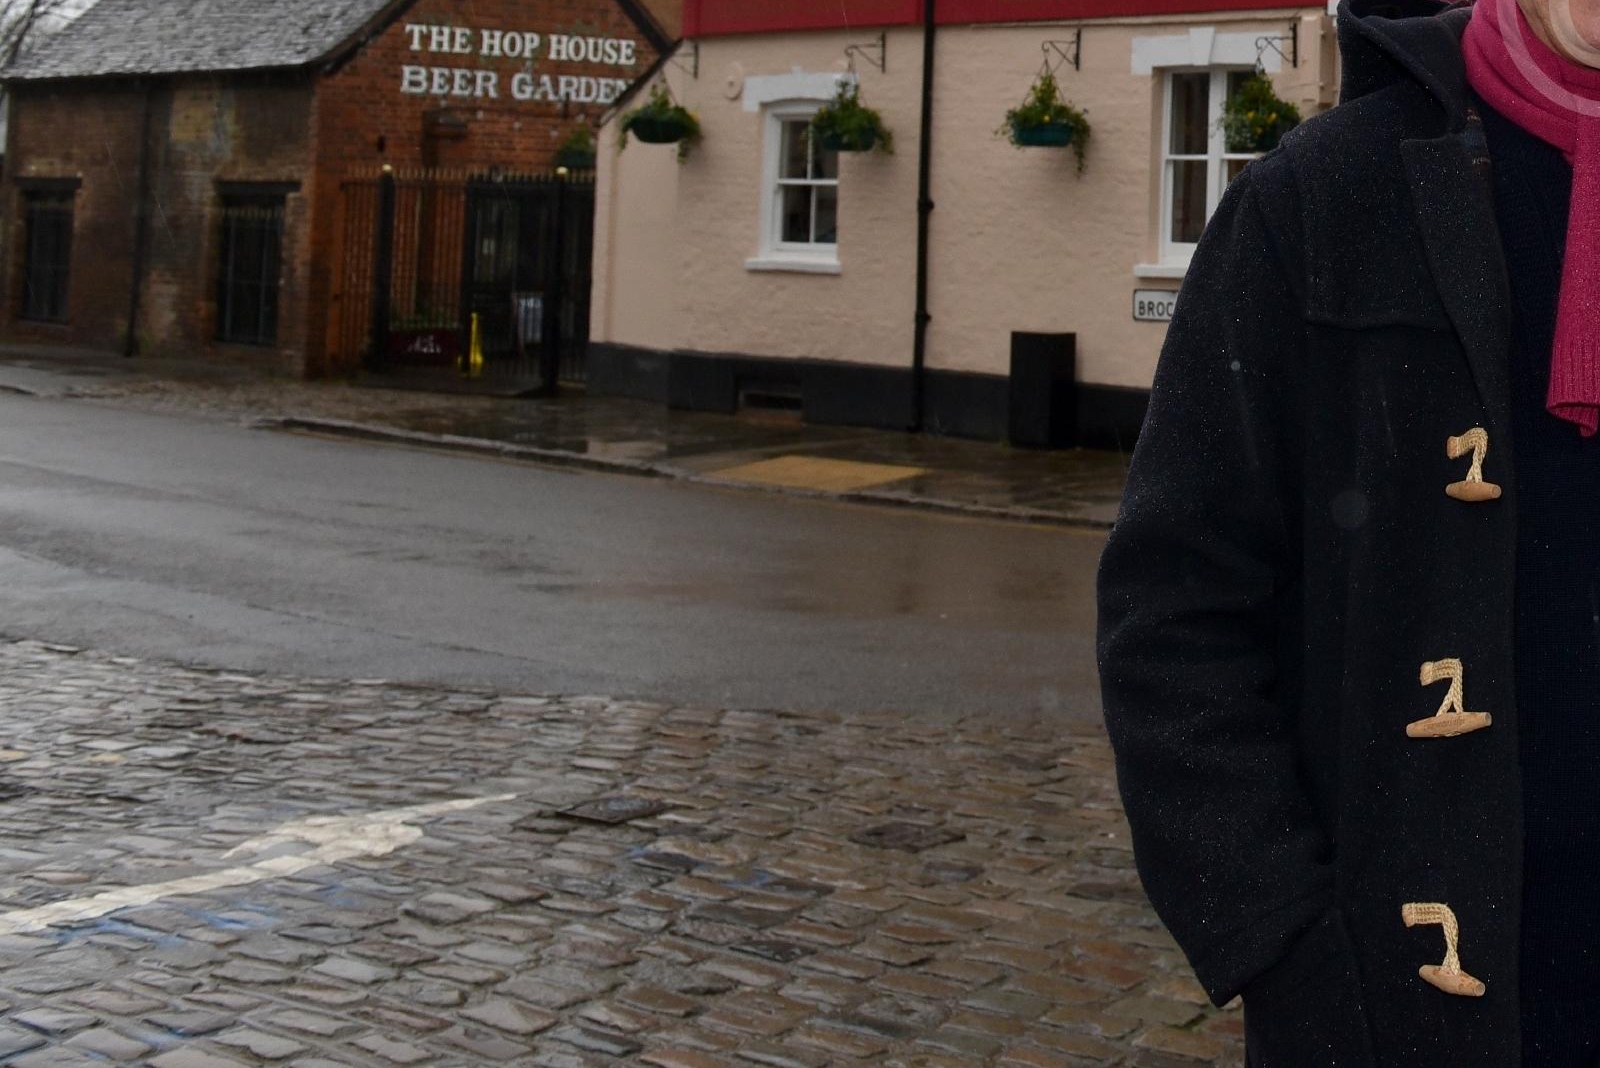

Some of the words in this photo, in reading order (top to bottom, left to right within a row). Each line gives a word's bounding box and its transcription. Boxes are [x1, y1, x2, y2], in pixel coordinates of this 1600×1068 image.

[405, 23, 472, 55] THE
[480, 29, 540, 59] HOP
[548, 35, 636, 65] HOUSE
[400, 65, 499, 99] BEER
